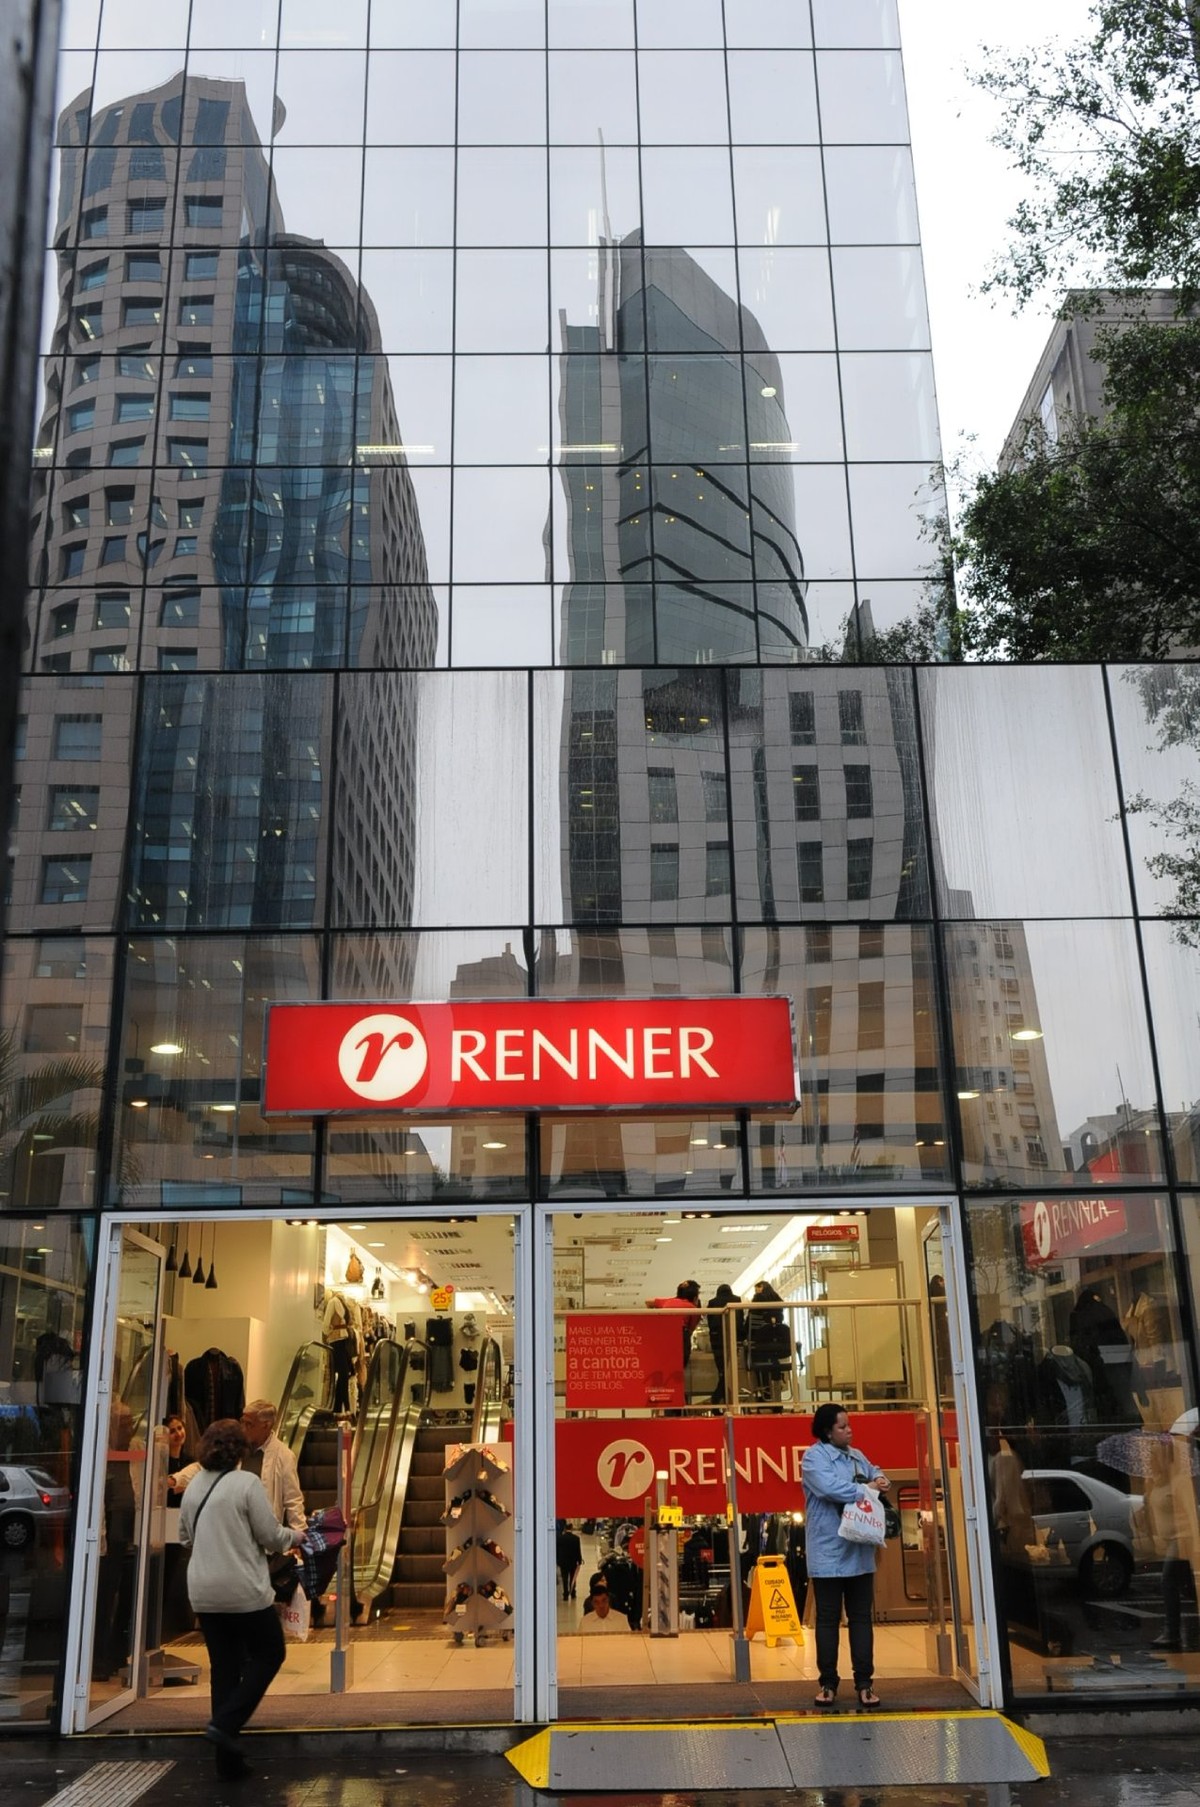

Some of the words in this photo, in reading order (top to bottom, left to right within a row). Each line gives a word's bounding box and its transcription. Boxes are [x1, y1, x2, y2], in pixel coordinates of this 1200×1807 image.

[451, 1026, 720, 1083] RENNER
[569, 1326, 592, 1335] MAIS
[593, 1326, 616, 1335] UMA
[569, 1336, 577, 1345] A
[578, 1336, 616, 1345] RENNER
[619, 1336, 642, 1345] TRAZ
[569, 1346, 594, 1355] PARA
[595, 1346, 603, 1355] O
[569, 1357, 578, 1369] a
[582, 1355, 640, 1369] cantora
[569, 1371, 590, 1380] QUE
[592, 1371, 611, 1380] TEM
[613, 1370, 645, 1380] TODOS
[569, 1381, 583, 1390] OS
[669, 1446, 804, 1486] RENNE
